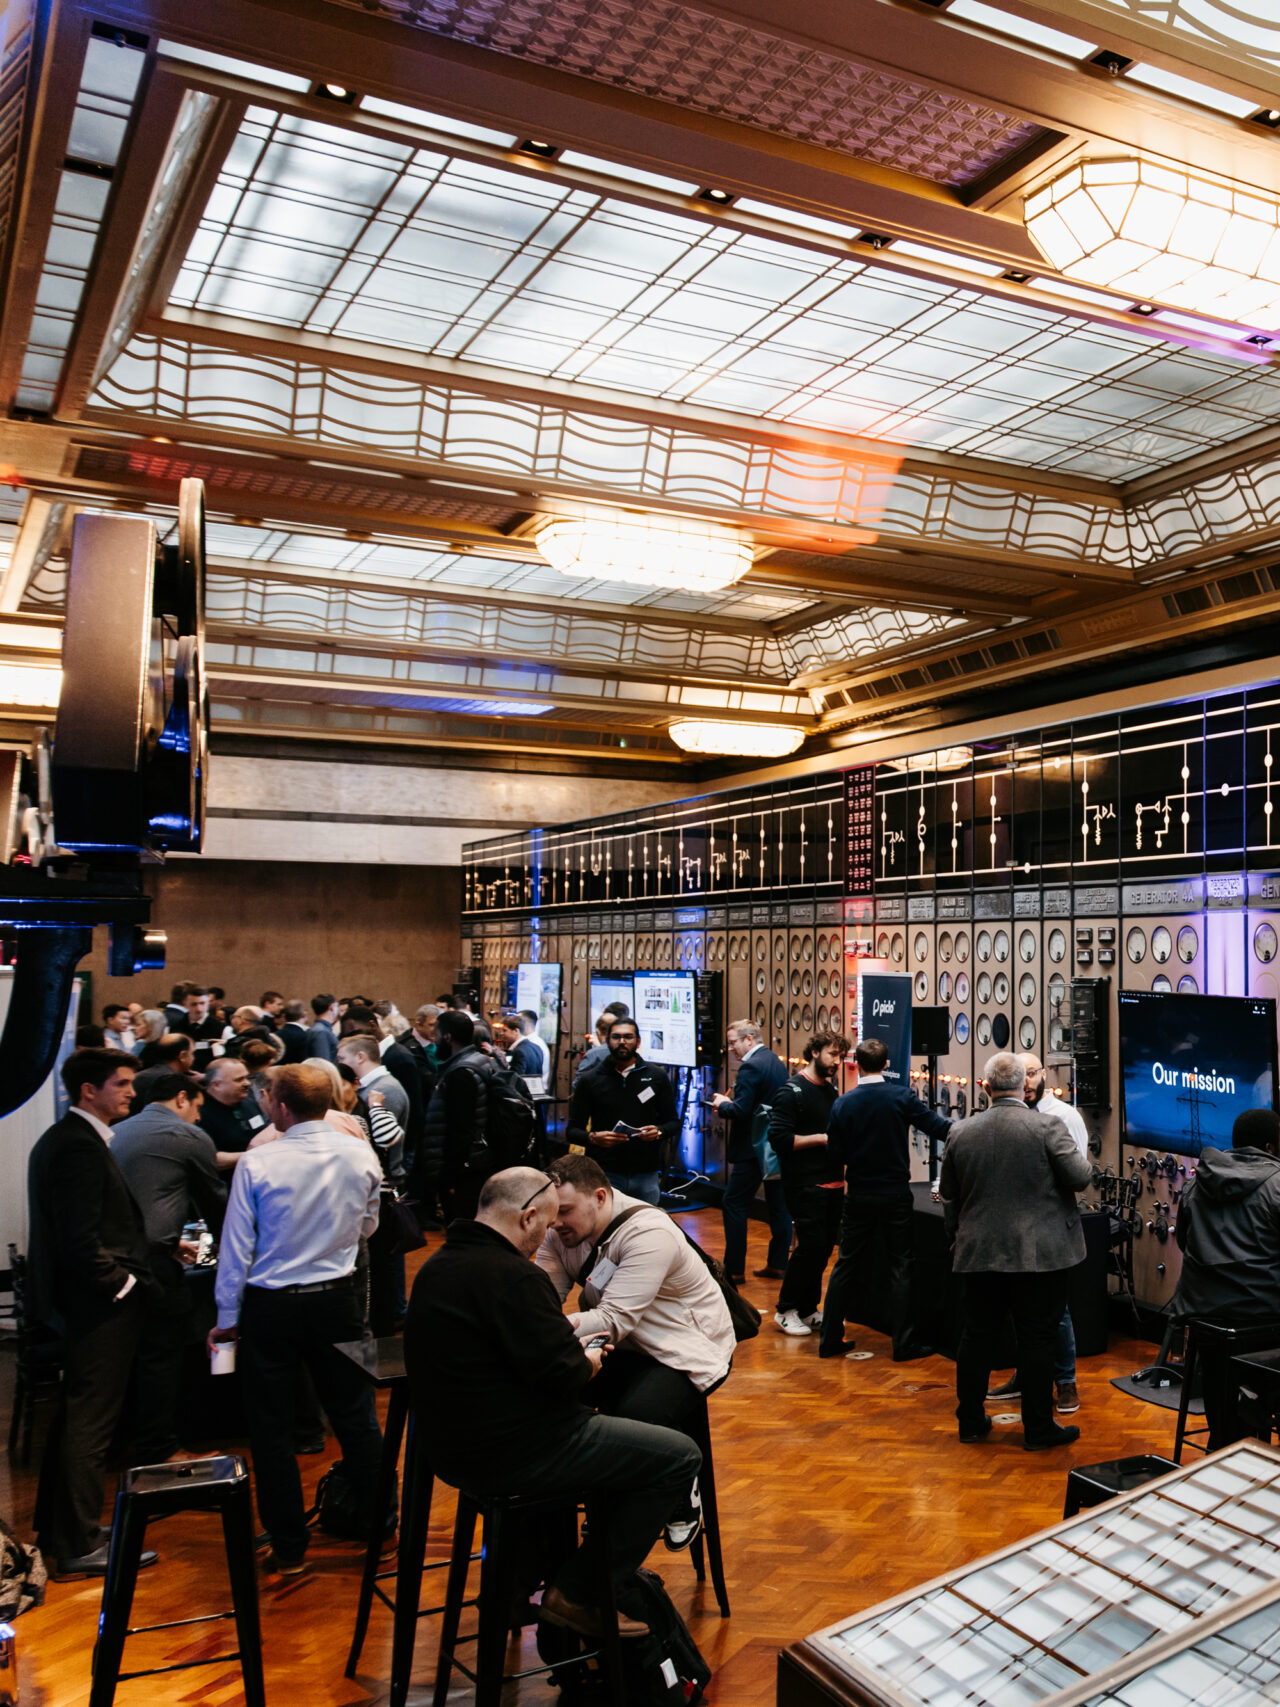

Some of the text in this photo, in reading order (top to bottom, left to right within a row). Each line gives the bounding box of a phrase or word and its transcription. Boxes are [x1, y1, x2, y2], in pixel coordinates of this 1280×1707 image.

[1130, 889, 1179, 905] GENERATOR
[1152, 1062, 1236, 1094] Our mission
